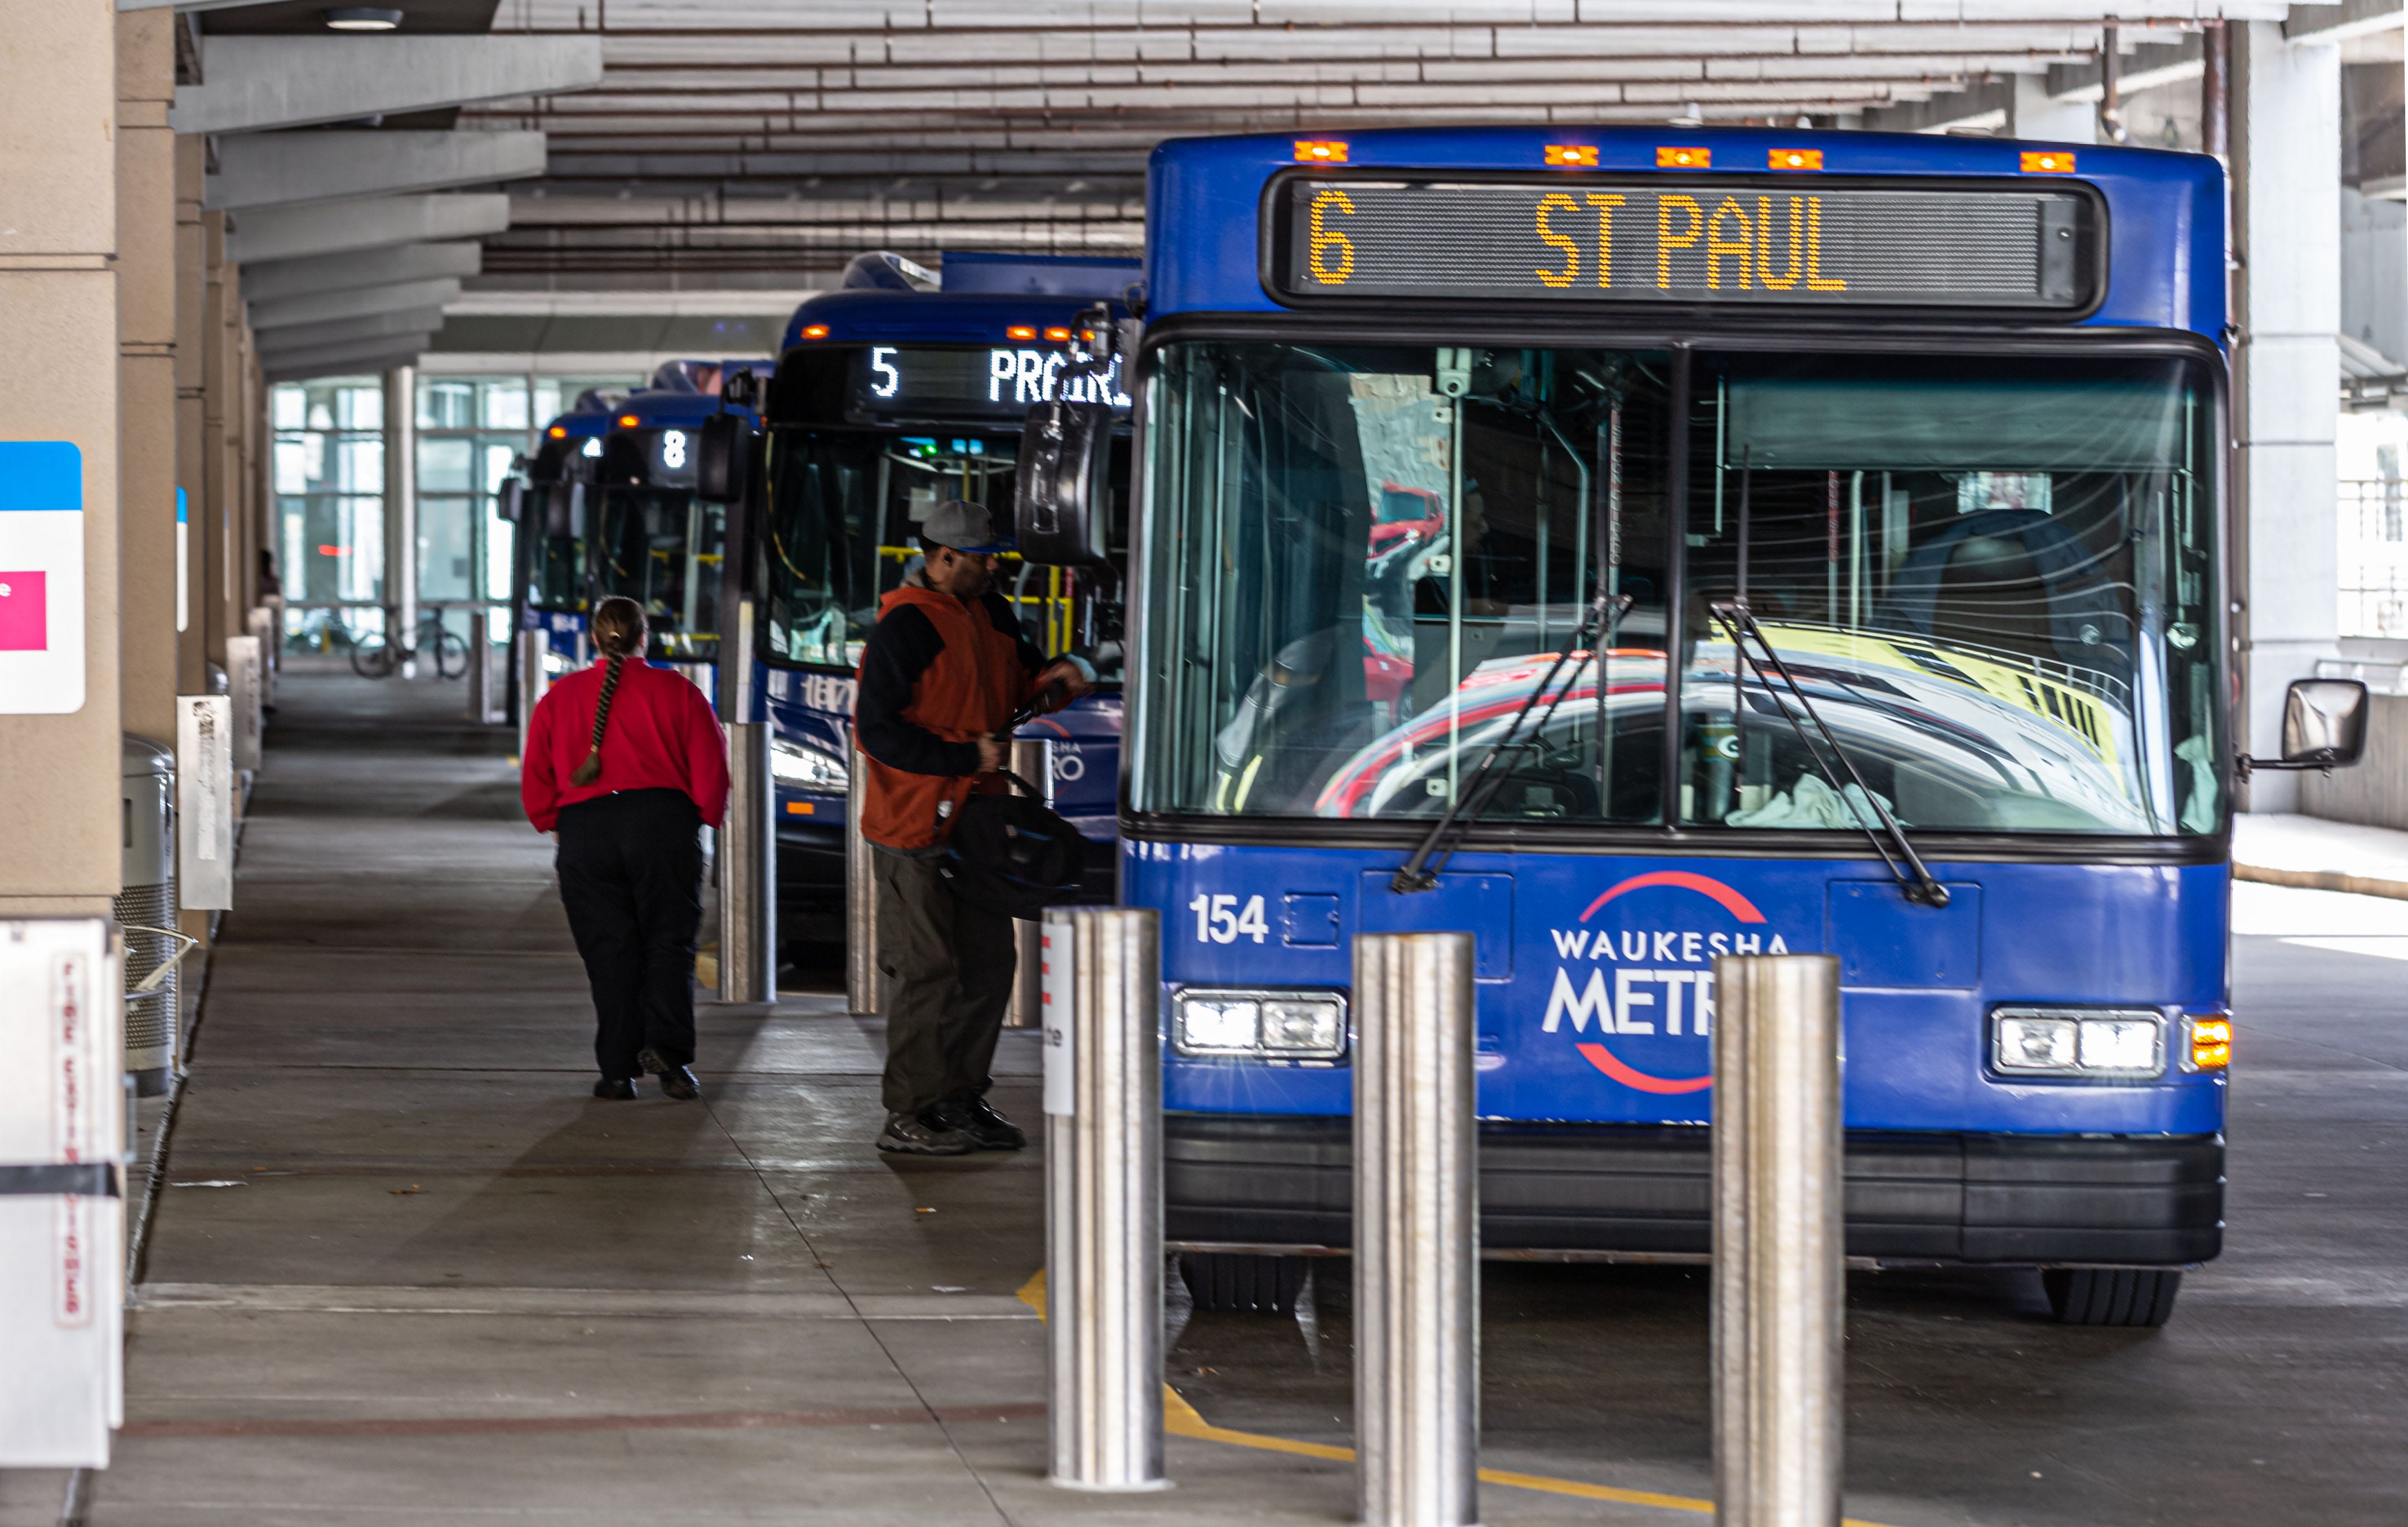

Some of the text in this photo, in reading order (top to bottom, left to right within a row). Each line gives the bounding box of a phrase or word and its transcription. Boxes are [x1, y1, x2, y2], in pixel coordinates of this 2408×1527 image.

[1310, 190, 1847, 291] 6 ST PAUL
[871, 346, 899, 397] 5
[663, 429, 687, 469] 8
[1189, 894, 1269, 944] 154
[1550, 929, 1789, 962] WAUKESHA
[1542, 966, 1716, 1036] METR
